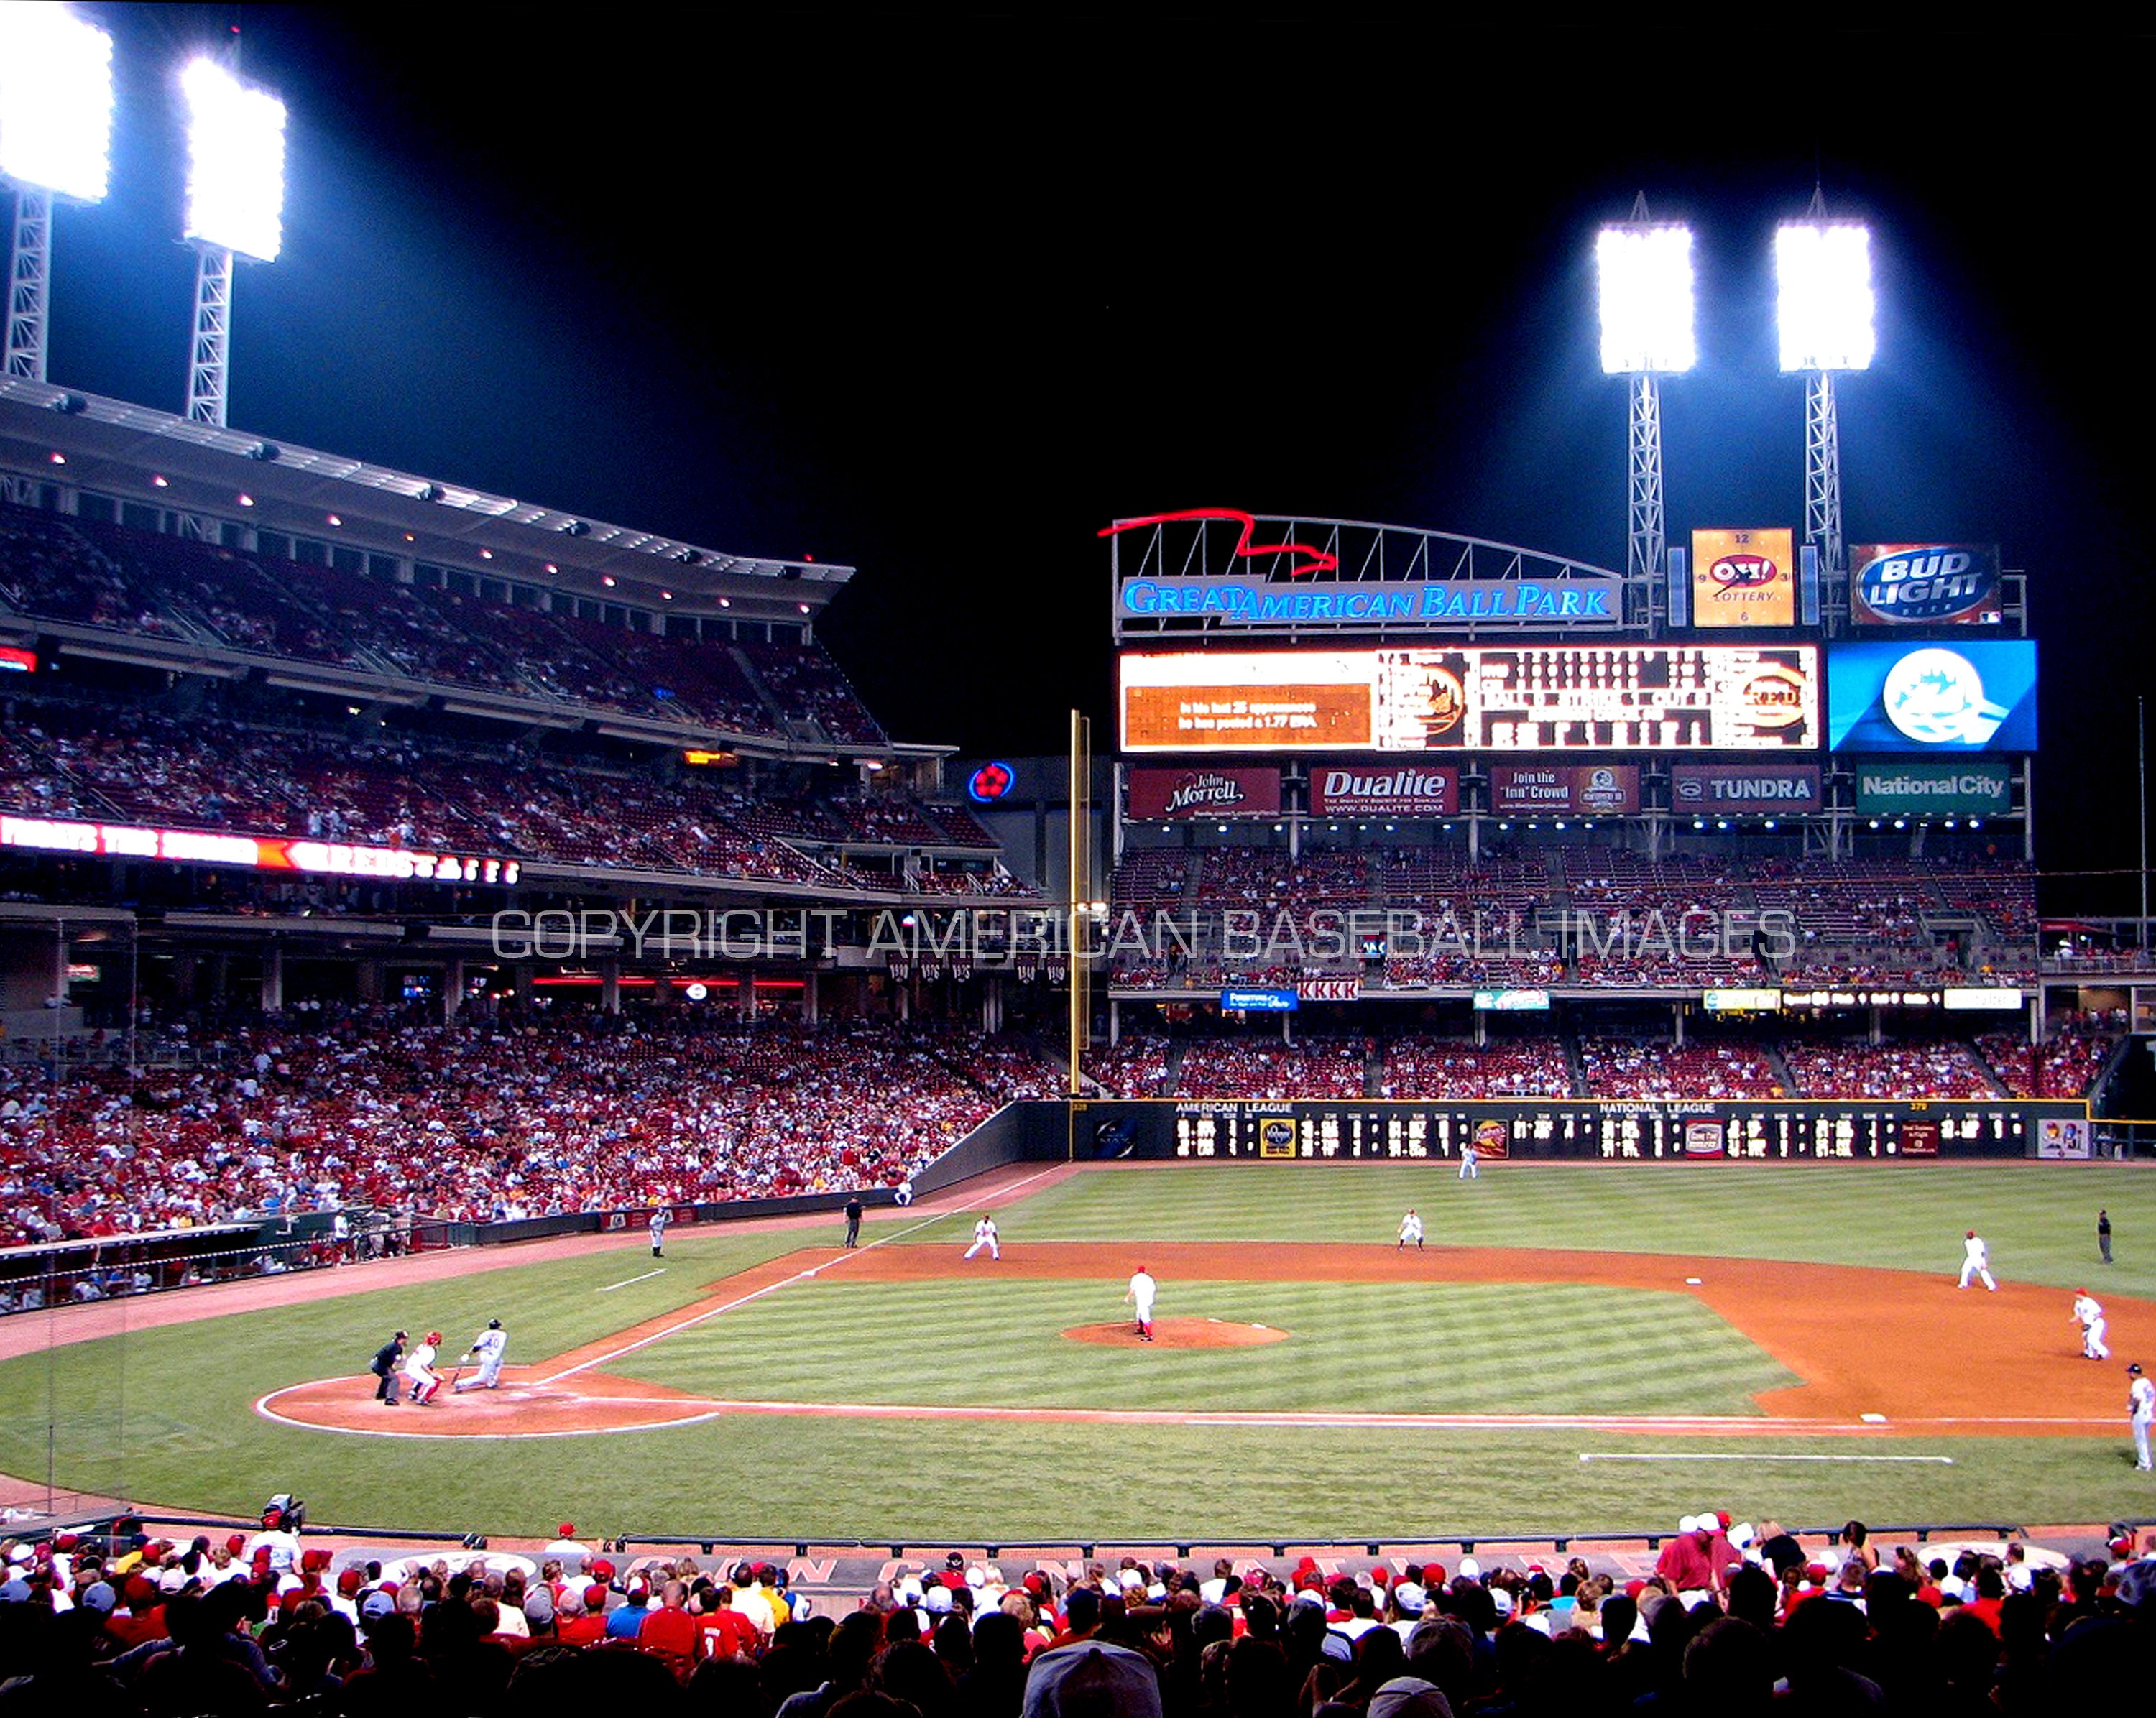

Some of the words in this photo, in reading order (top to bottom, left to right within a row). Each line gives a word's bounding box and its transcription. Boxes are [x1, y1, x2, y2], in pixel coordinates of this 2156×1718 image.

[1735, 533, 1750, 544] 12
[1881, 551, 1971, 583] BUD
[1713, 591, 1774, 602] LOTTERY
[1870, 572, 1983, 606] LIGHT
[1124, 580, 1247, 614] GREAT
[1230, 588, 1416, 620] AMERICAN
[1419, 584, 1511, 618] BALL
[1512, 583, 1611, 616] PARK
[1195, 773, 1224, 789] John
[1323, 768, 1446, 797] Dualite
[1513, 771, 1536, 784] Join
[1537, 770, 1555, 783] the
[1530, 785, 1569, 799] Crowd
[1710, 778, 1811, 799] TUNDRA
[1862, 775, 1958, 795] National
[1958, 775, 2004, 798] City
[1164, 780, 1244, 813] Morrell
[1175, 1102, 1238, 1113] AMERICAN
[1245, 1102, 1293, 1113] LEAGUE
[1600, 1102, 1659, 1113] NATIONAL
[1667, 1102, 1715, 1113] LEAGUE
